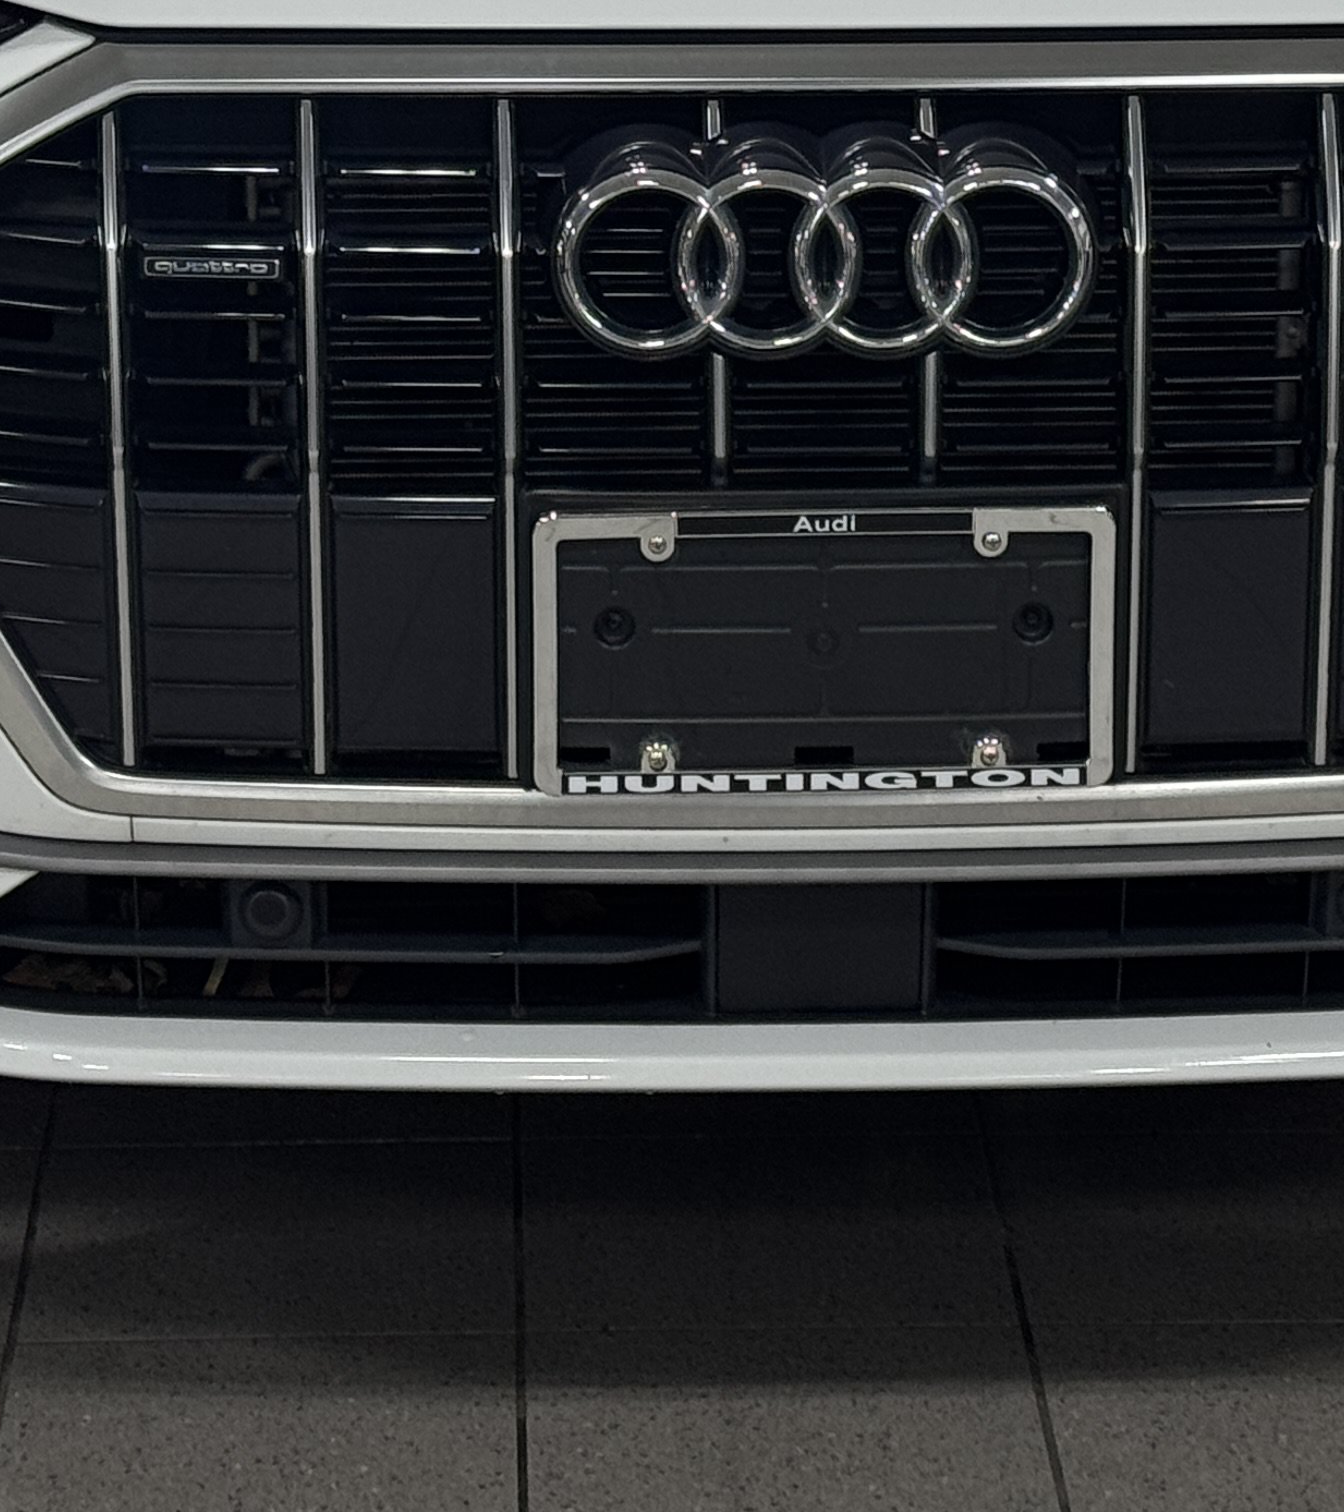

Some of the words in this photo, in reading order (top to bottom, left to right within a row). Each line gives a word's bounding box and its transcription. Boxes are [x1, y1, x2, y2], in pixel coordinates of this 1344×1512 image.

[154, 260, 269, 275] quattro
[792, 513, 857, 533] Audi
[567, 767, 1081, 794] HUNTINGTON
